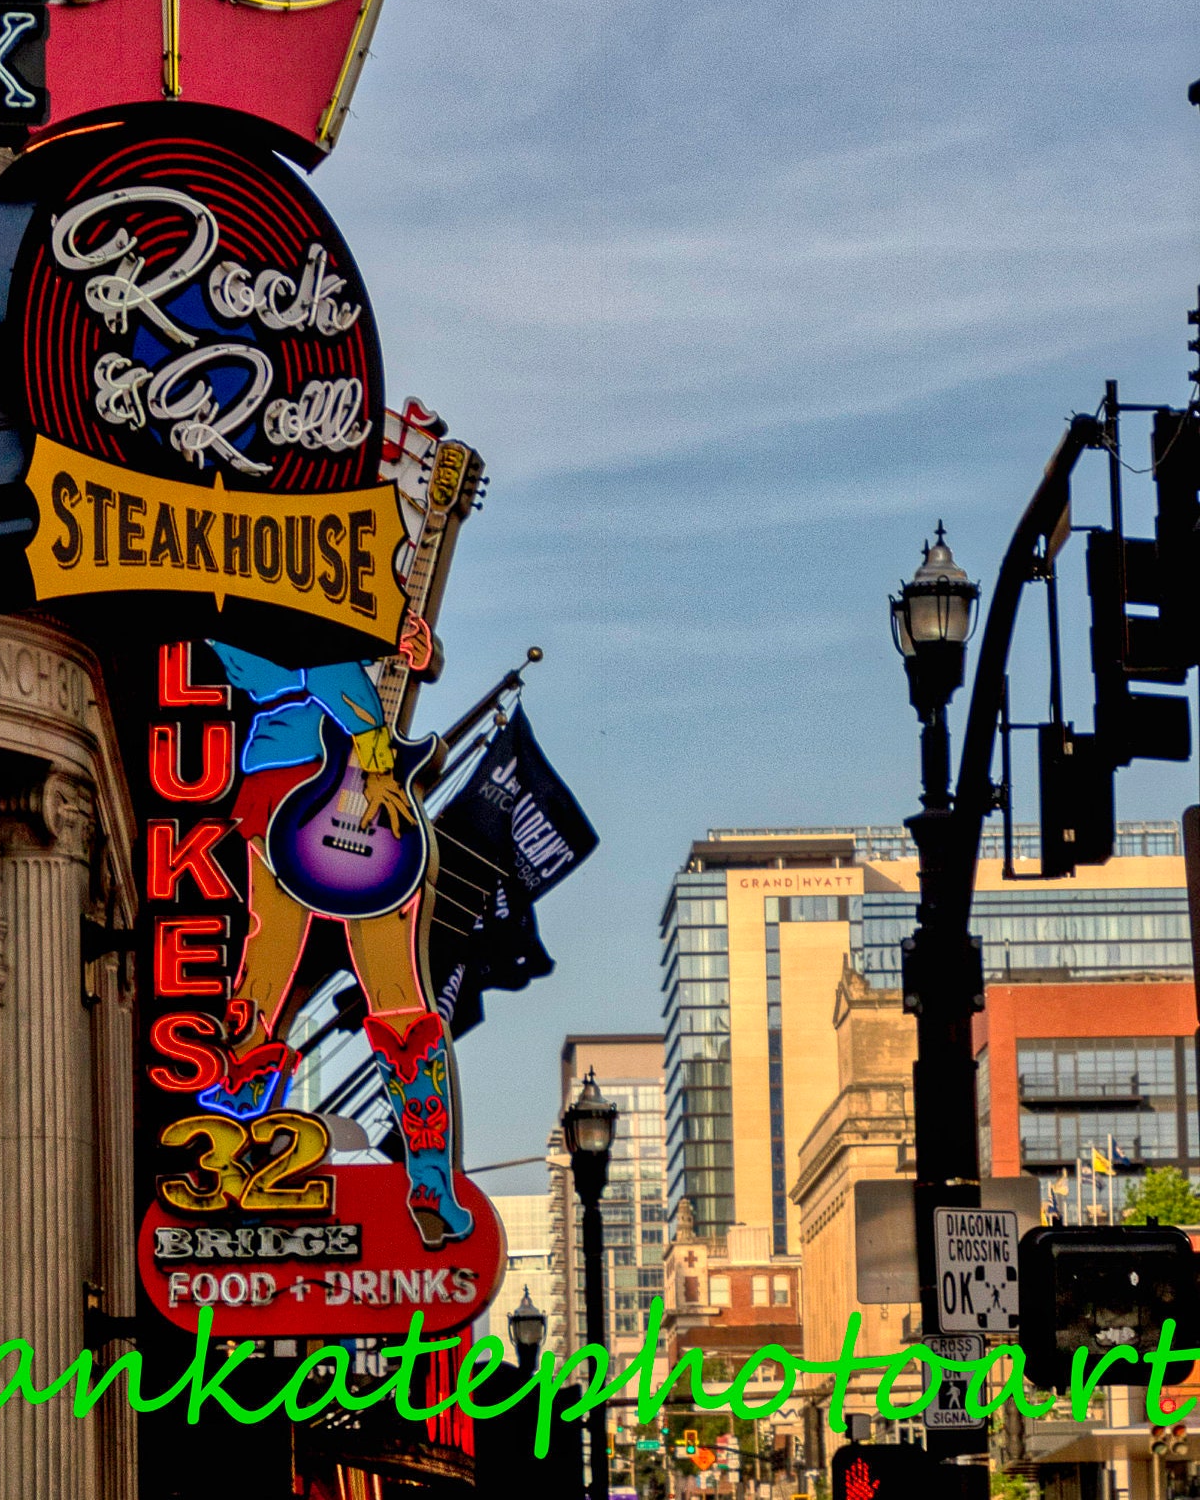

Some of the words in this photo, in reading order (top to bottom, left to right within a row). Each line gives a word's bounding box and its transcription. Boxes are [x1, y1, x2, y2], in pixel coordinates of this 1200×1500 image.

[51, 185, 362, 347] Rock
[94, 351, 154, 430] &
[147, 343, 374, 476] Roll
[50, 470, 378, 618] STEAKHOUSE
[147, 641, 257, 1093] LUKE'S
[740, 878, 793, 889] GRAND
[802, 876, 853, 887] HYATT
[158, 1113, 336, 1213] 32
[154, 1225, 358, 1258] BRIDGE
[946, 1214, 1009, 1238] DIAGONAL
[948, 1239, 1010, 1262] CROSSING
[168, 1271, 277, 1308] FOOD
[324, 1267, 480, 1306] DRINKS
[942, 1270, 975, 1315] OK
[931, 1339, 972, 1352] CROSS
